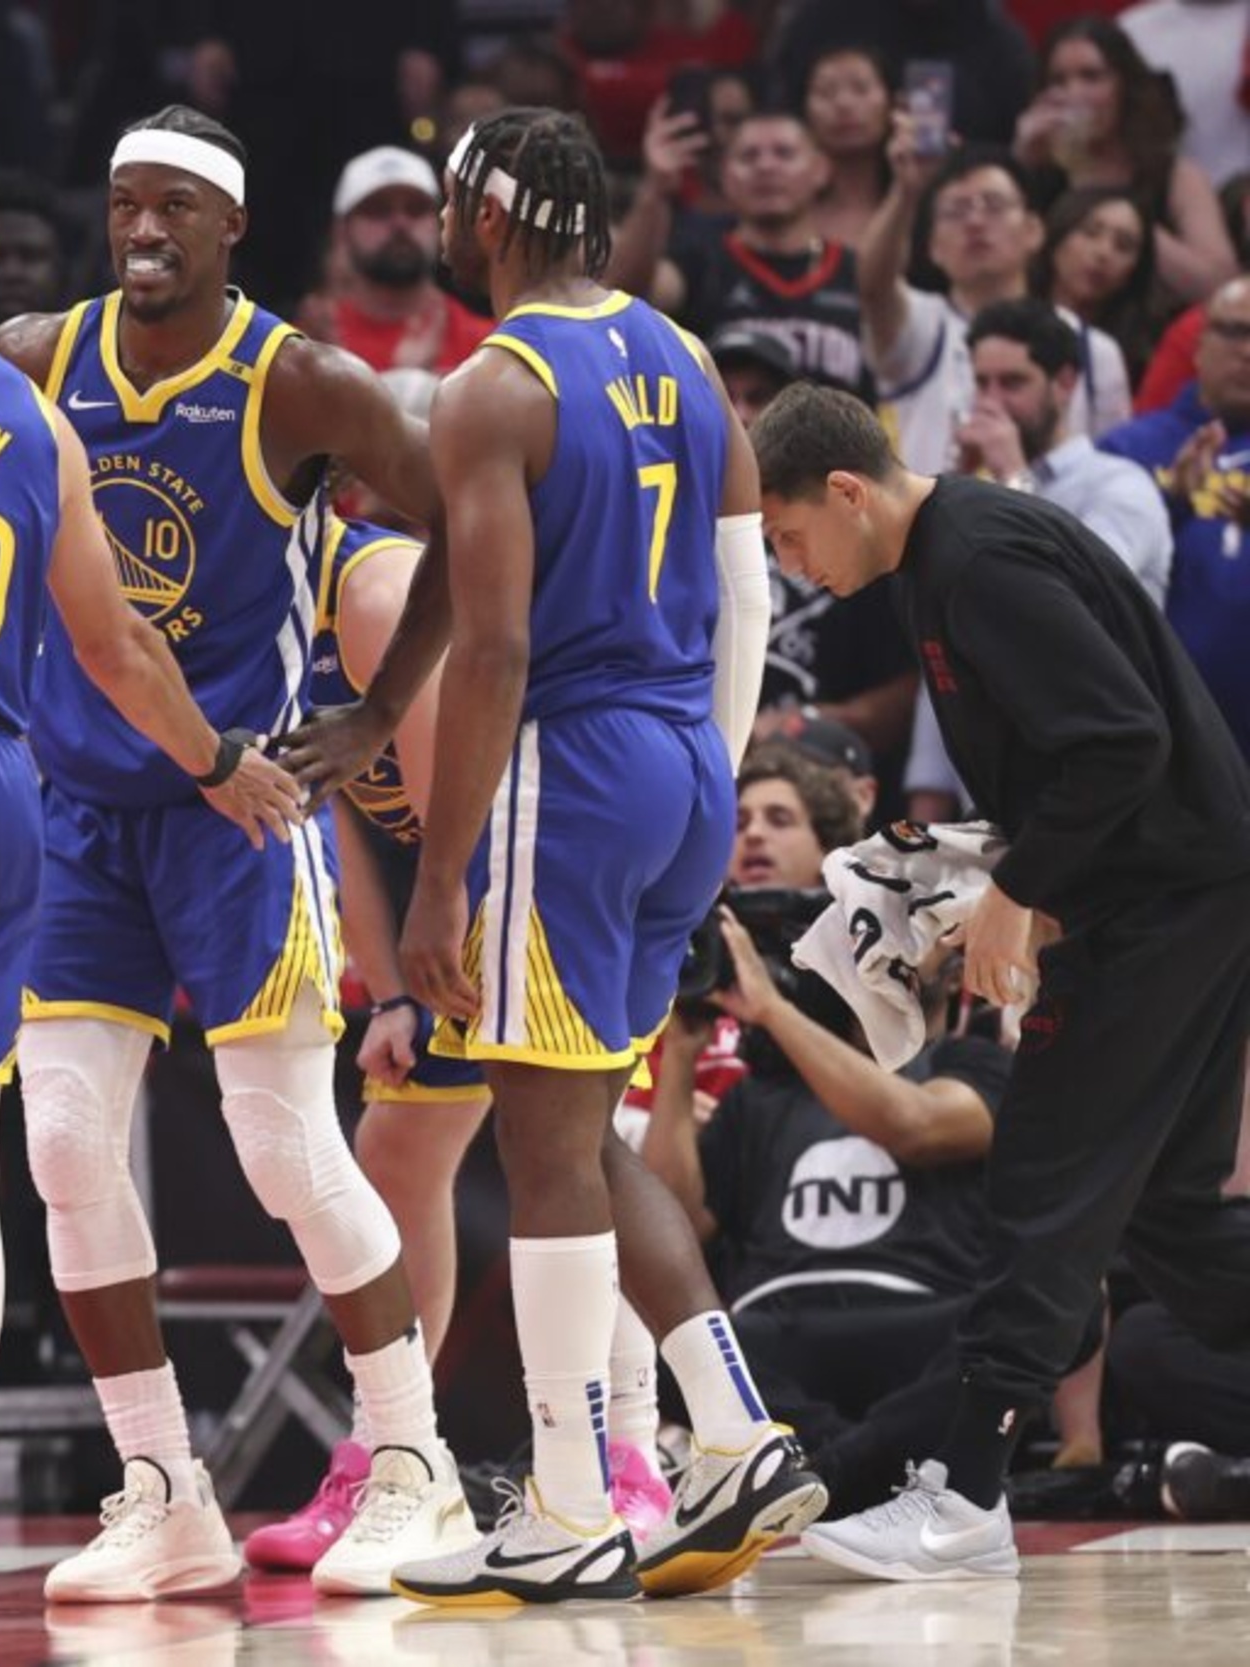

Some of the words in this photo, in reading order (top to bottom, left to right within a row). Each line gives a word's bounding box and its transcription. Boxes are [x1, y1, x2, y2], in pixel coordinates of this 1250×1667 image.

[176, 403, 236, 422] Rakuten
[148, 462, 204, 515] STATE
[145, 519, 179, 560] 10
[637, 463, 677, 604] 7
[791, 1173, 901, 1220] TNT
